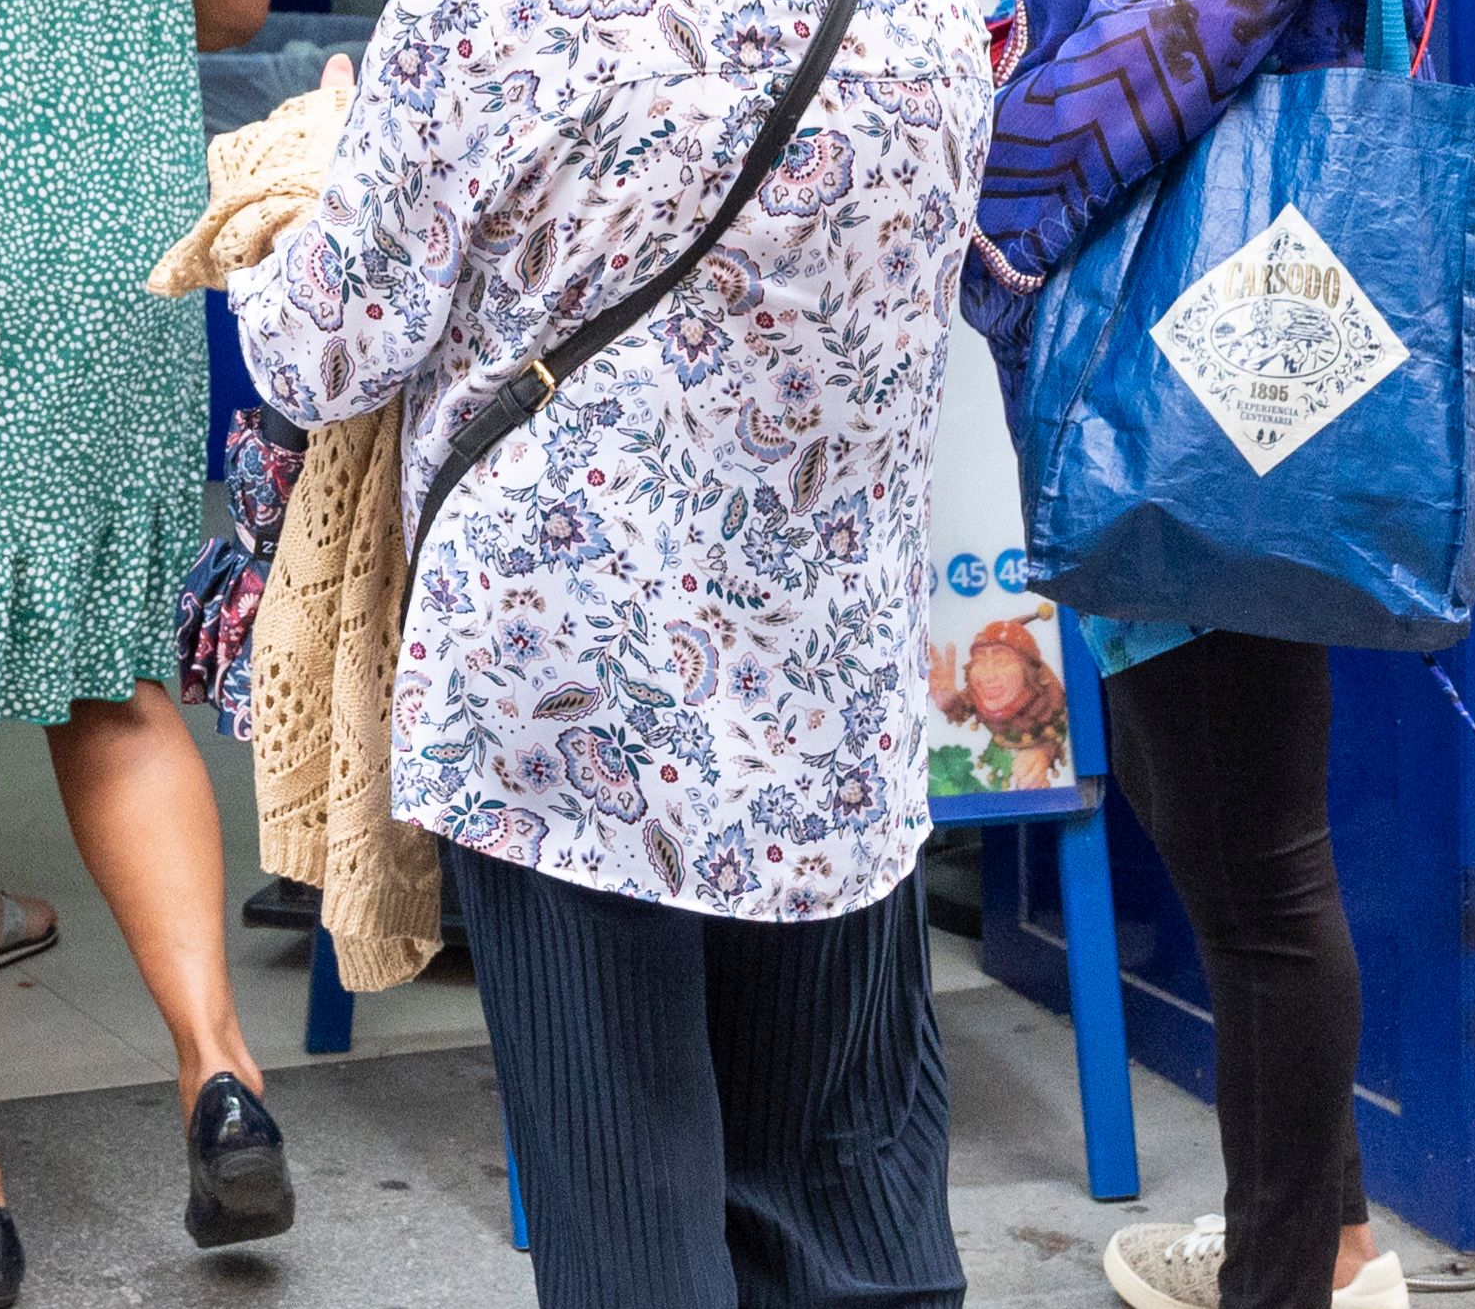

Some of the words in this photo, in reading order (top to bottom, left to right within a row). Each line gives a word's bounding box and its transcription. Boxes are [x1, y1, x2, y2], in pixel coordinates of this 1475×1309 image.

[1249, 380, 1290, 403] 1895
[1236, 400, 1300, 417] EXPERIENCIA
[1239, 411, 1293, 427] CENTENARIA
[952, 564, 987, 590] 45
